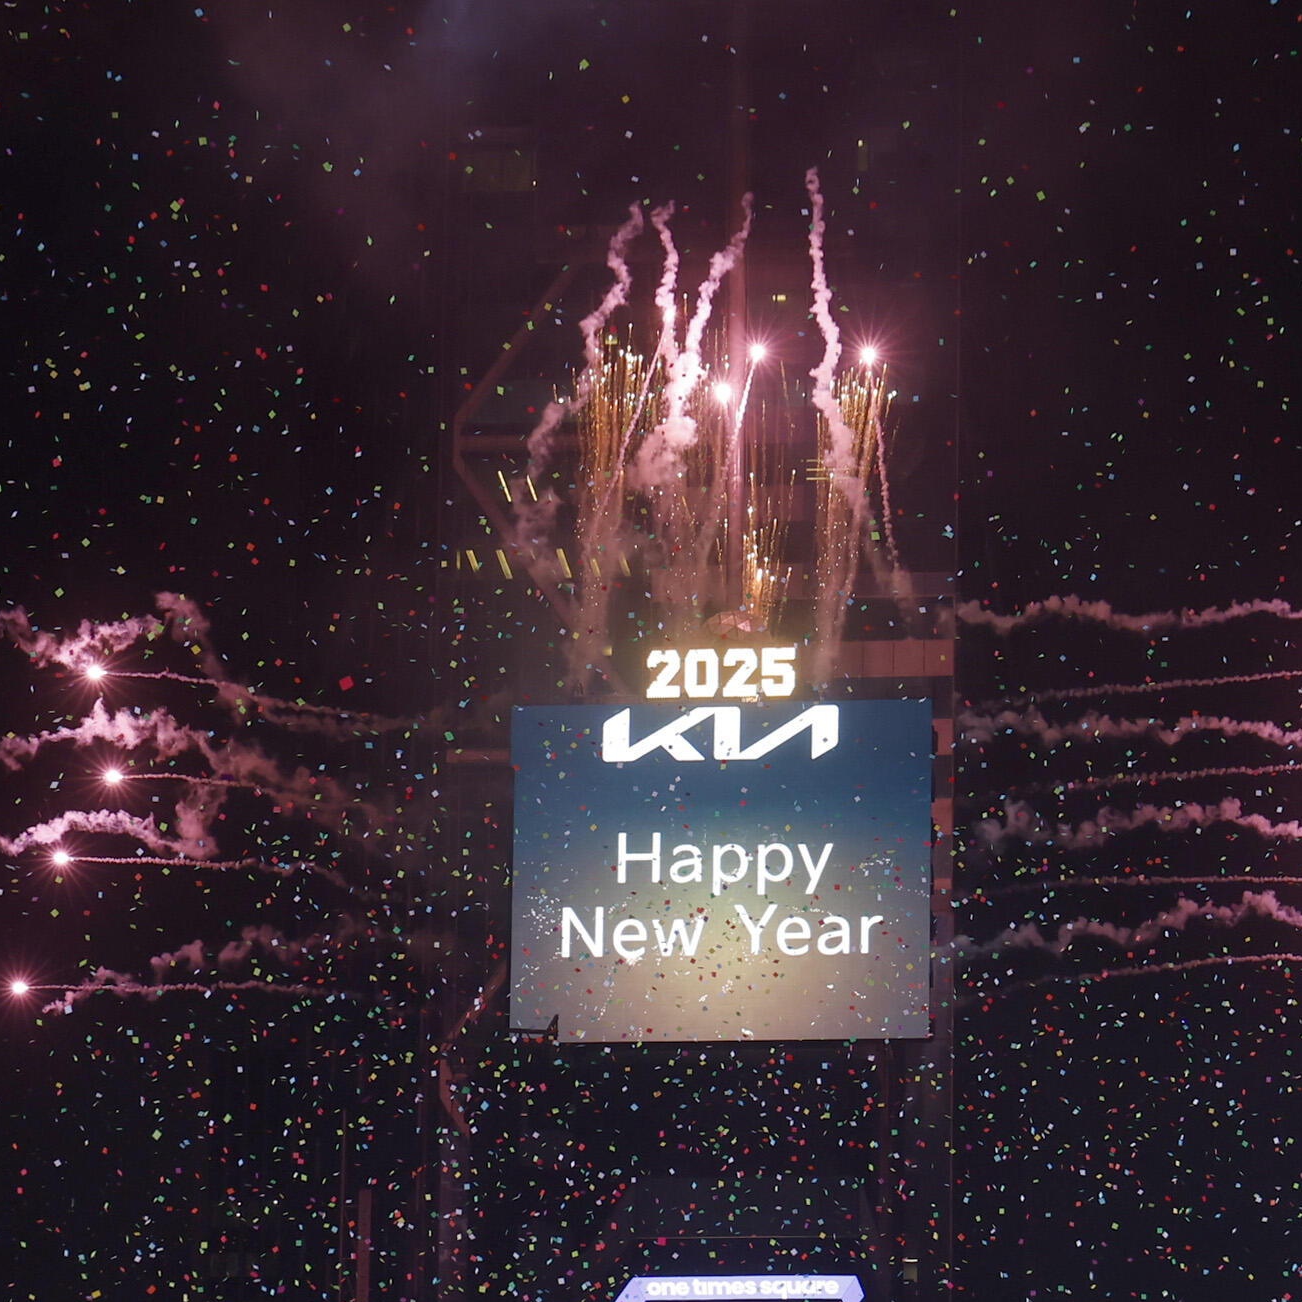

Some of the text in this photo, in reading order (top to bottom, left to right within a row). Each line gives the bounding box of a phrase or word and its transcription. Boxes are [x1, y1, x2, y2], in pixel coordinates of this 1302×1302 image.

[646, 648, 797, 699] 2025
[602, 704, 840, 763] KIA
[616, 831, 833, 896] Happy
[560, 903, 884, 958] New Year
[646, 1278, 840, 1300] one times square
